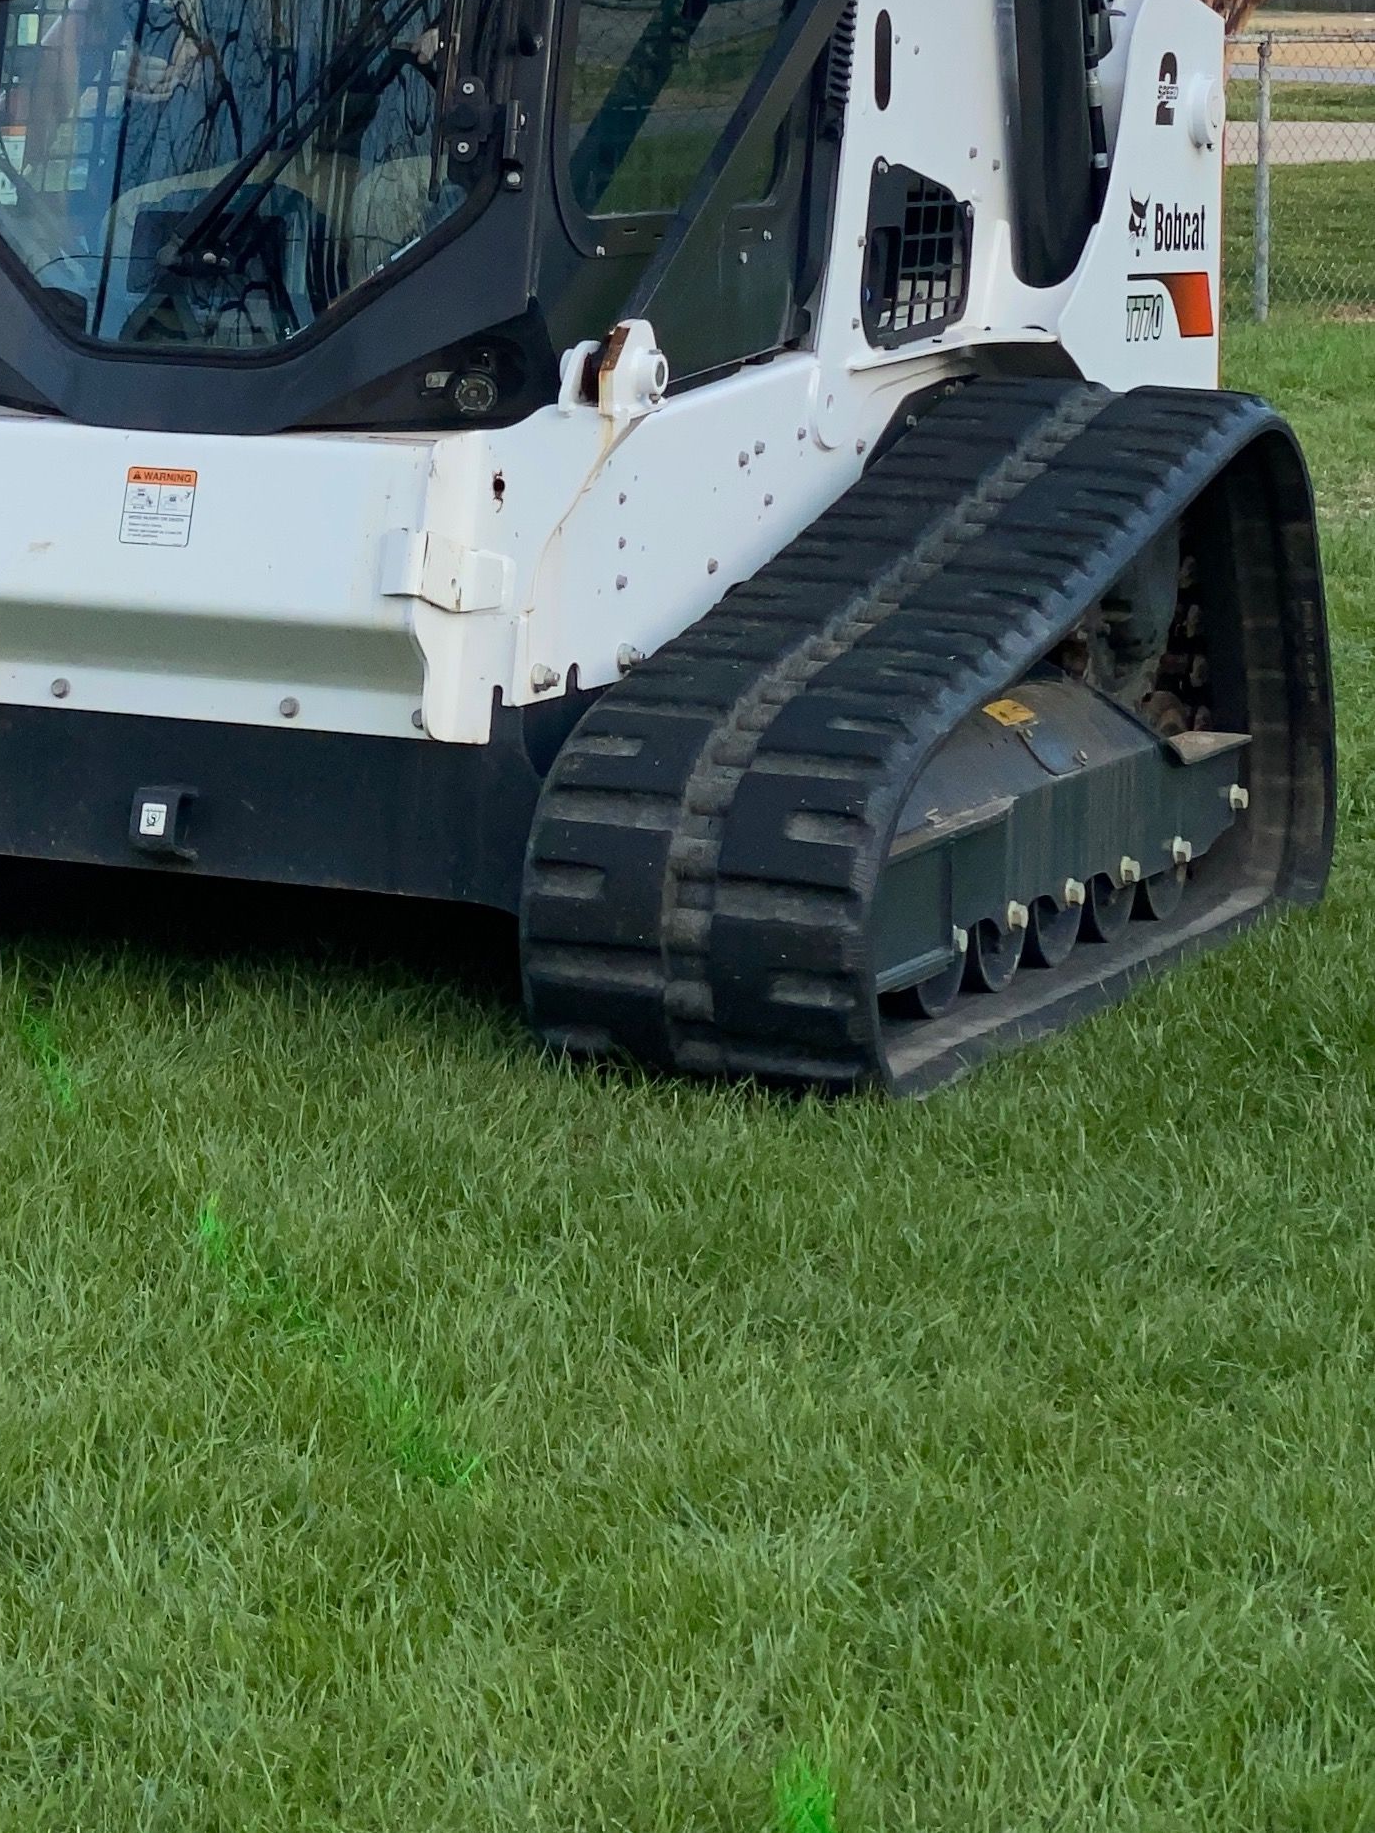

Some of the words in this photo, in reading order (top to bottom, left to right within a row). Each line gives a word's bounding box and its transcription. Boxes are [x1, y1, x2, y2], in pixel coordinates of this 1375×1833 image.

[1154, 202, 1206, 252] Bobcat
[1126, 293, 1164, 343] T770
[144, 470, 192, 484] WARNING
